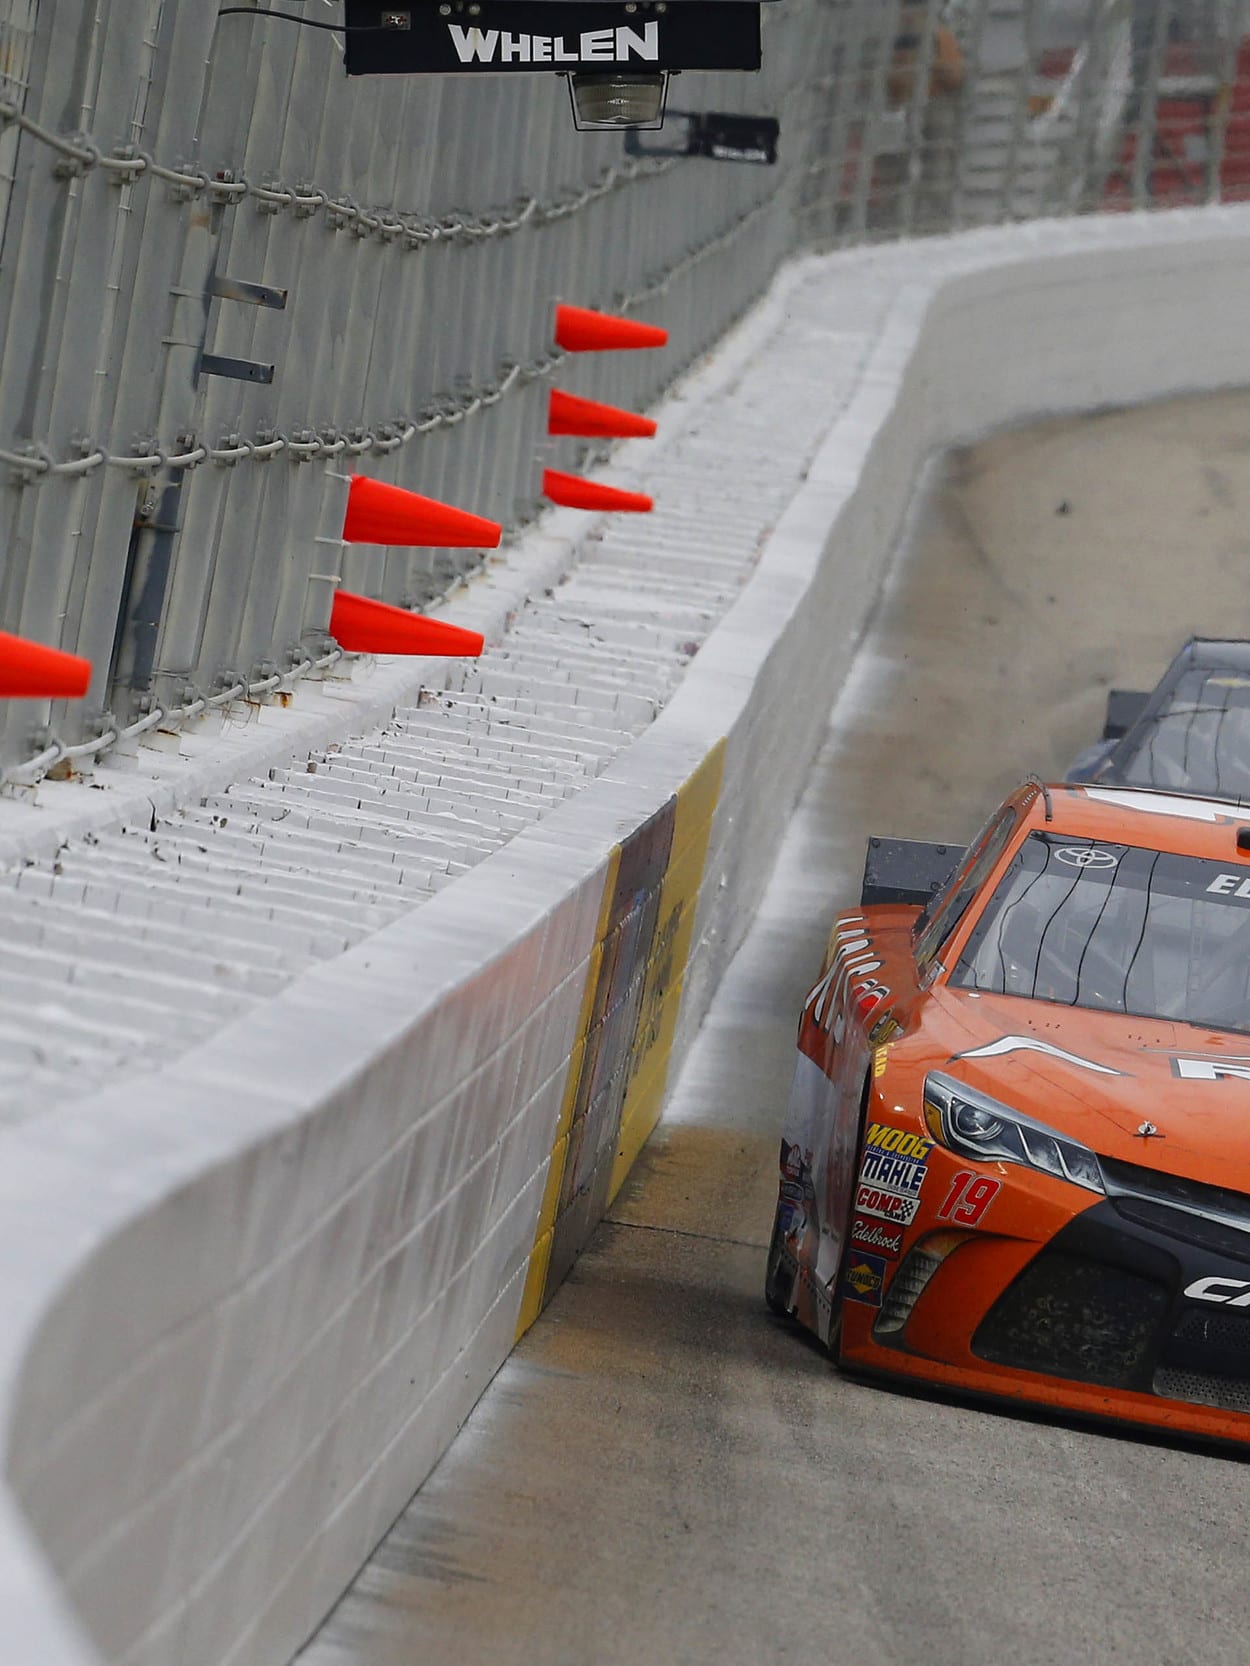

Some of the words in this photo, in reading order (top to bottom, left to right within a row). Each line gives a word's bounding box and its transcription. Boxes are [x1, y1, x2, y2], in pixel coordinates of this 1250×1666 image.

[447, 20, 659, 63] WHELEN
[866, 1123, 934, 1159] MOOG
[863, 1153, 926, 1191] MAHLE
[857, 1188, 902, 1213] COMP
[936, 1170, 1002, 1227] 19
[851, 1220, 901, 1252] Edelbrock
